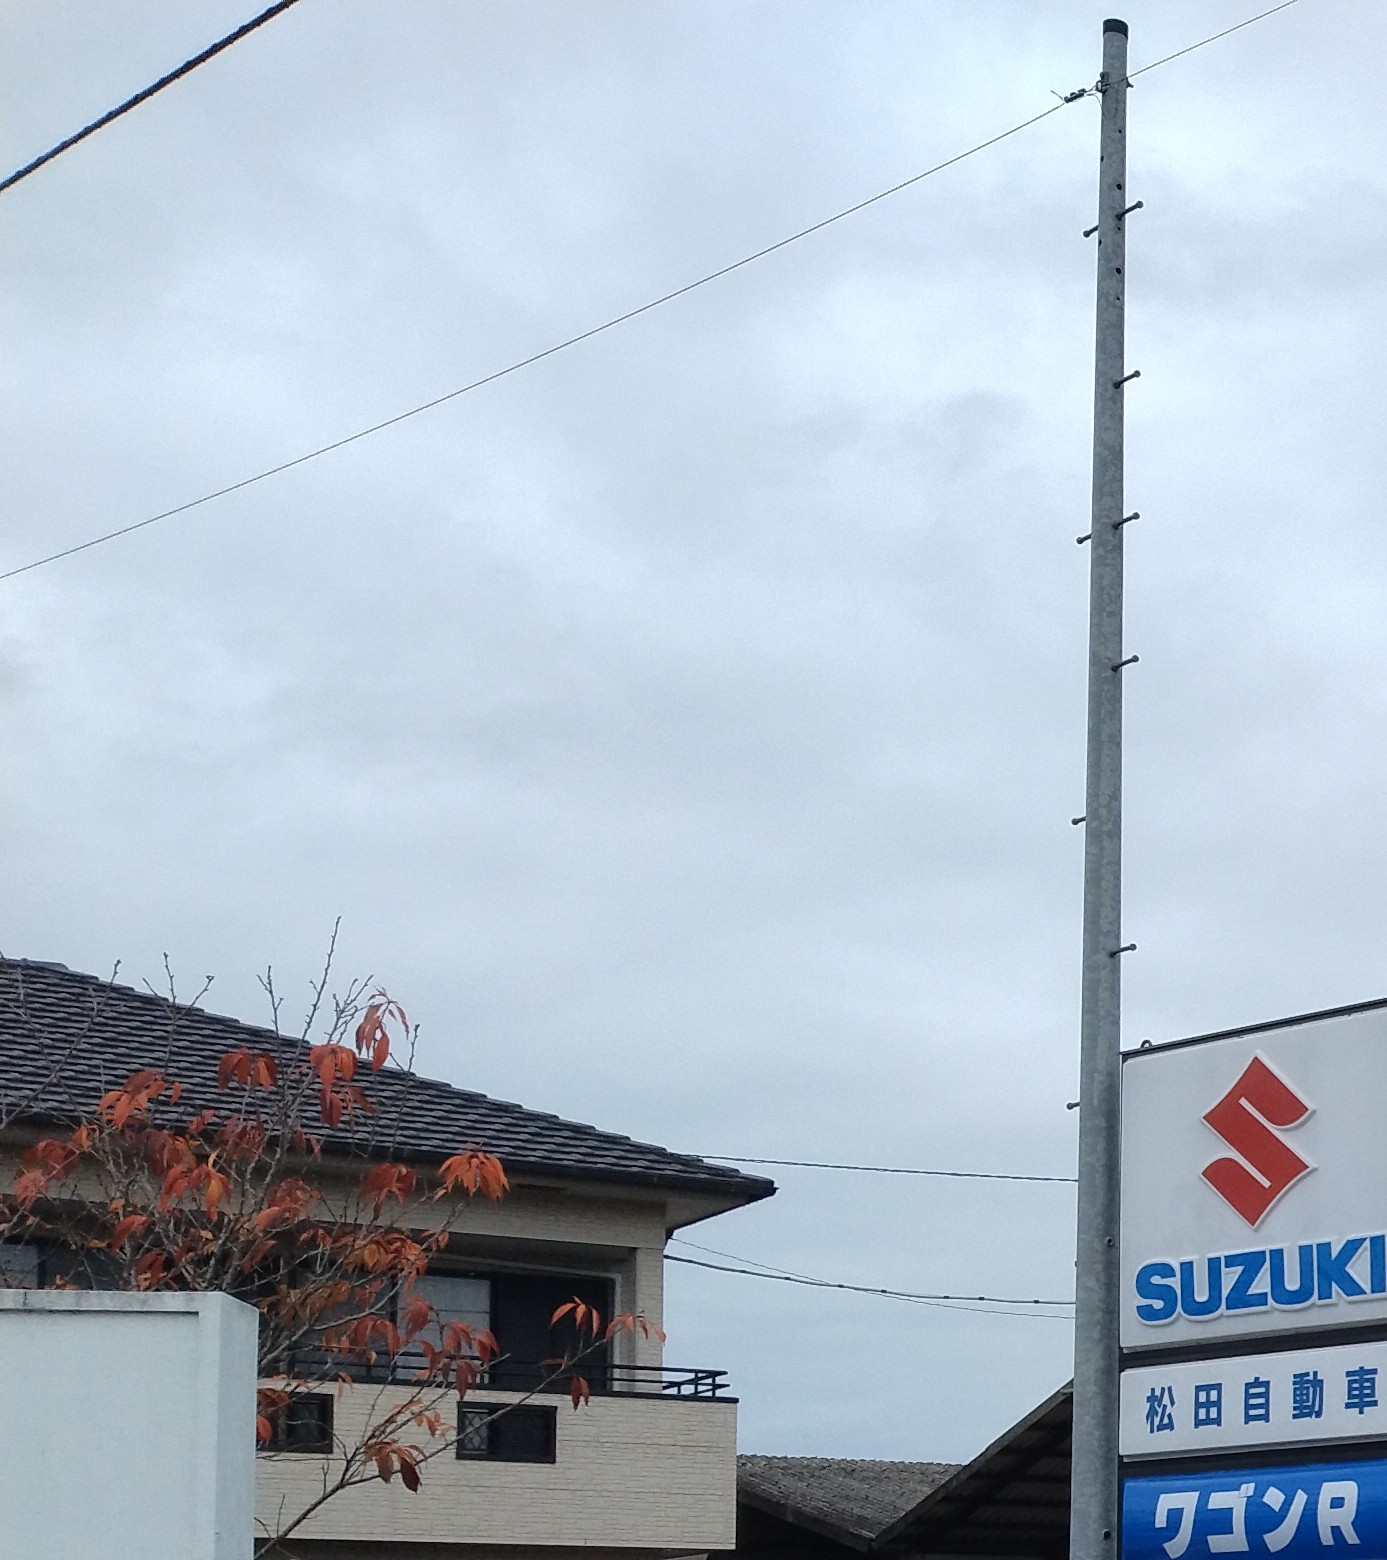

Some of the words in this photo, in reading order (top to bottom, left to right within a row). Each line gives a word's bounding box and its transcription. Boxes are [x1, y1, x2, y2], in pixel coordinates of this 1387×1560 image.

[1135, 1233, 1387, 1324] SUZUKI
[1145, 1366, 1379, 1434] 松田自動車
[1153, 1479, 1361, 1560] ワゴンR
